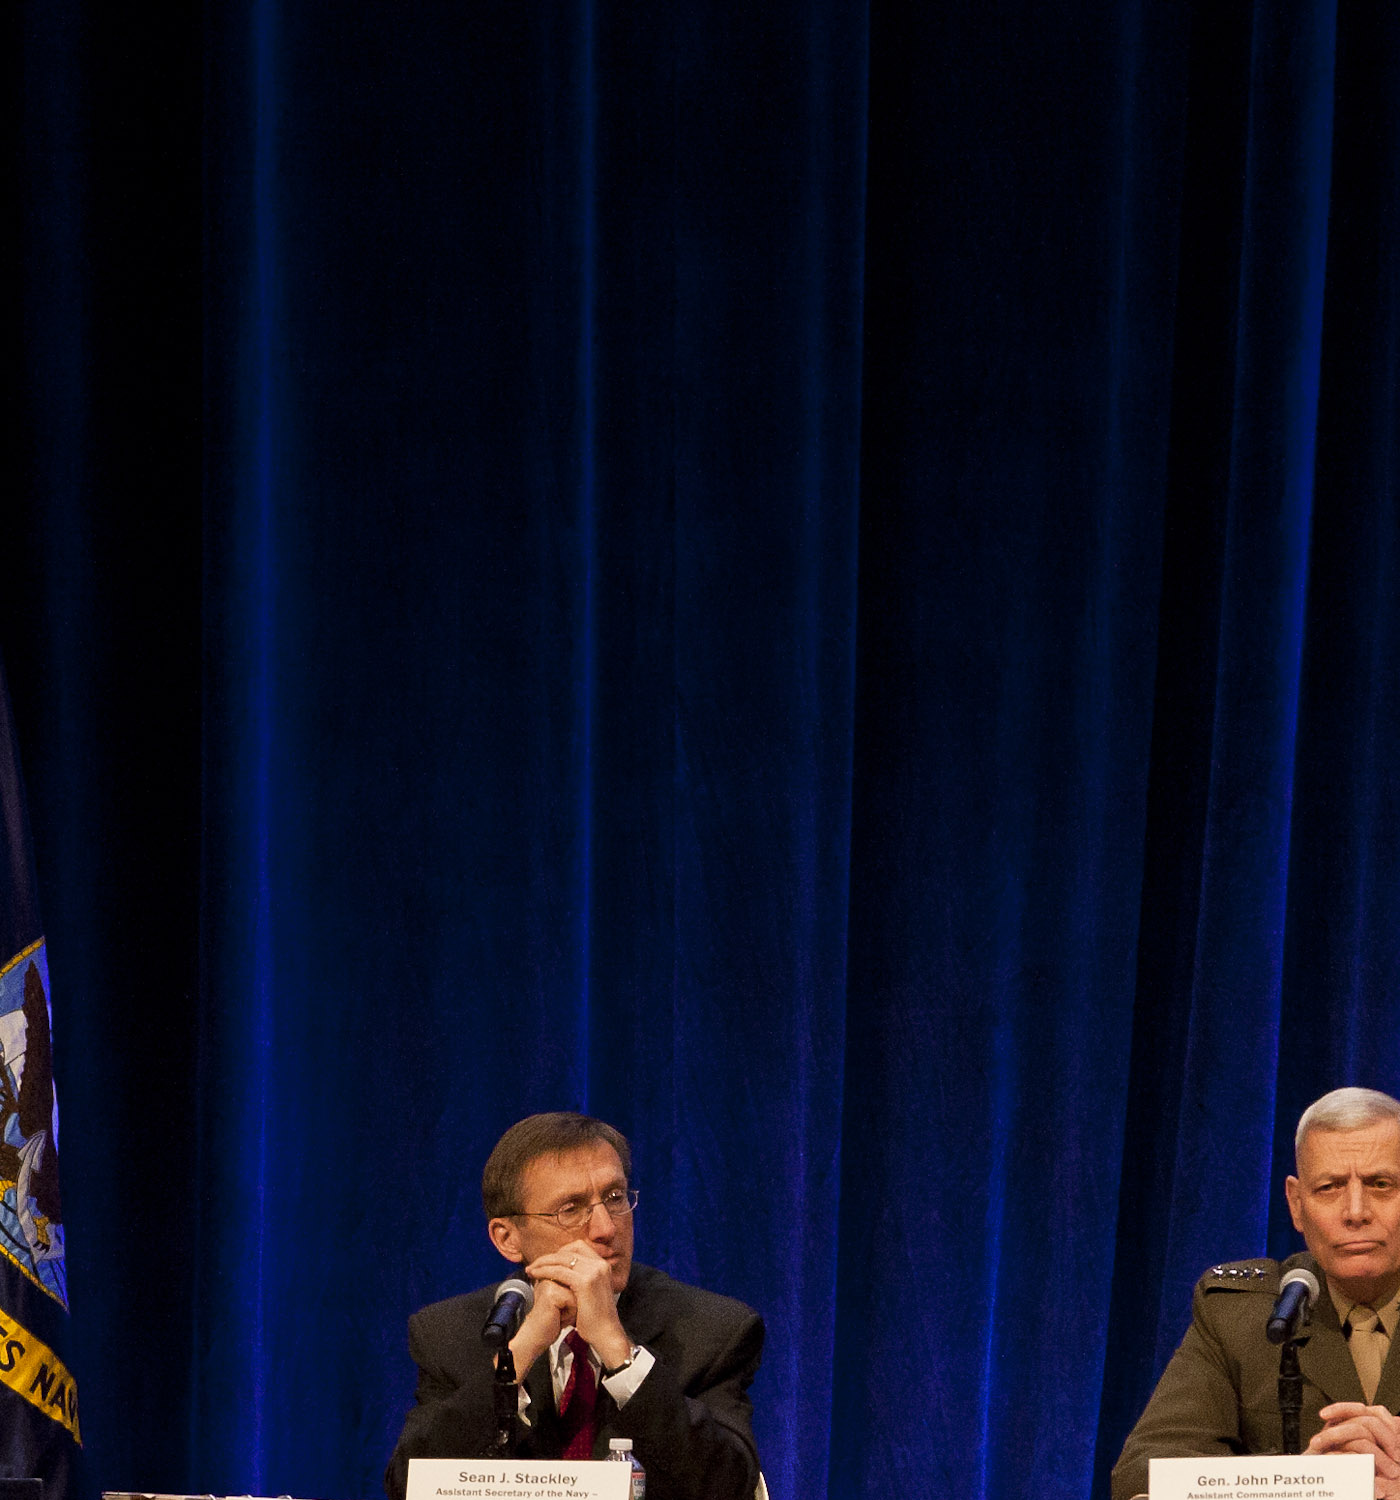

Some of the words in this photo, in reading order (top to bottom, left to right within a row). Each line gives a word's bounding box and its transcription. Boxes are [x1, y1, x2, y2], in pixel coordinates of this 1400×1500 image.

[29, 1361, 78, 1422] NAV
[459, 1472, 495, 1483] Sean
[500, 1473, 510, 1483] J.
[515, 1473, 578, 1486] Stackley
[1198, 1476, 1230, 1486] Gen.
[1234, 1475, 1268, 1486] John
[1273, 1474, 1324, 1485] Paxton
[436, 1488, 482, 1496] Assistant
[485, 1489, 532, 1498] Secretary
[535, 1489, 545, 1497] of
[566, 1490, 589, 1499] Navy
[1187, 1491, 1233, 1499] Assistant
[1237, 1490, 1303, 1499] Commandant
[1306, 1490, 1316, 1498] of
[1319, 1489, 1334, 1498] the
